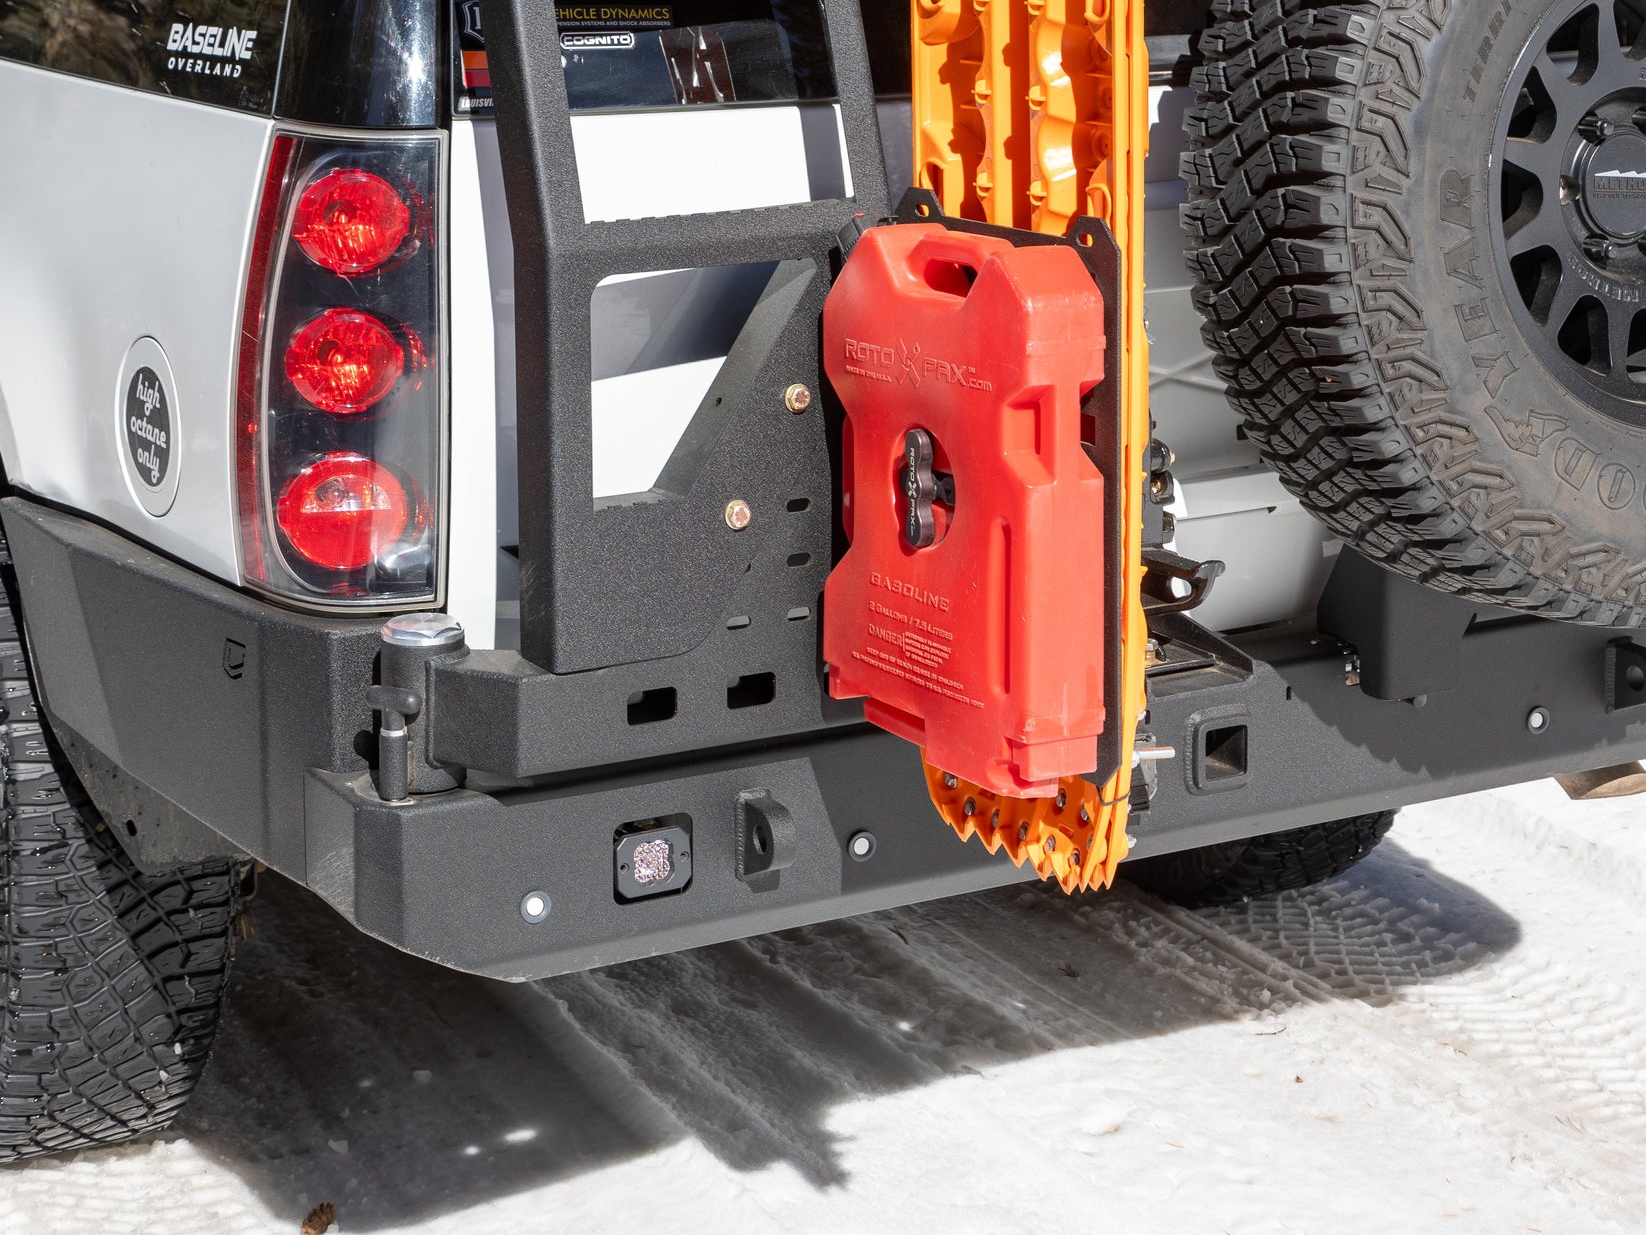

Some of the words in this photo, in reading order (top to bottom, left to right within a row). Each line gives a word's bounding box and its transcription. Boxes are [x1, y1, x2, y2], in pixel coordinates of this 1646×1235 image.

[555, 8, 597, 19] EHICLE
[600, 8, 670, 19] DYNAMICS
[166, 22, 258, 61] BASELINE
[563, 35, 631, 46] COGNITO
[167, 56, 242, 78] OVERLAND
[461, 98, 494, 108] LOUISVI
[1594, 176, 1646, 190] METHO
[845, 338, 895, 368] ROTO
[136, 373, 161, 417] high
[130, 416, 167, 449] octane
[137, 444, 160, 484] only
[869, 571, 950, 612] GASOLINE
[868, 623, 903, 649] DANGER
